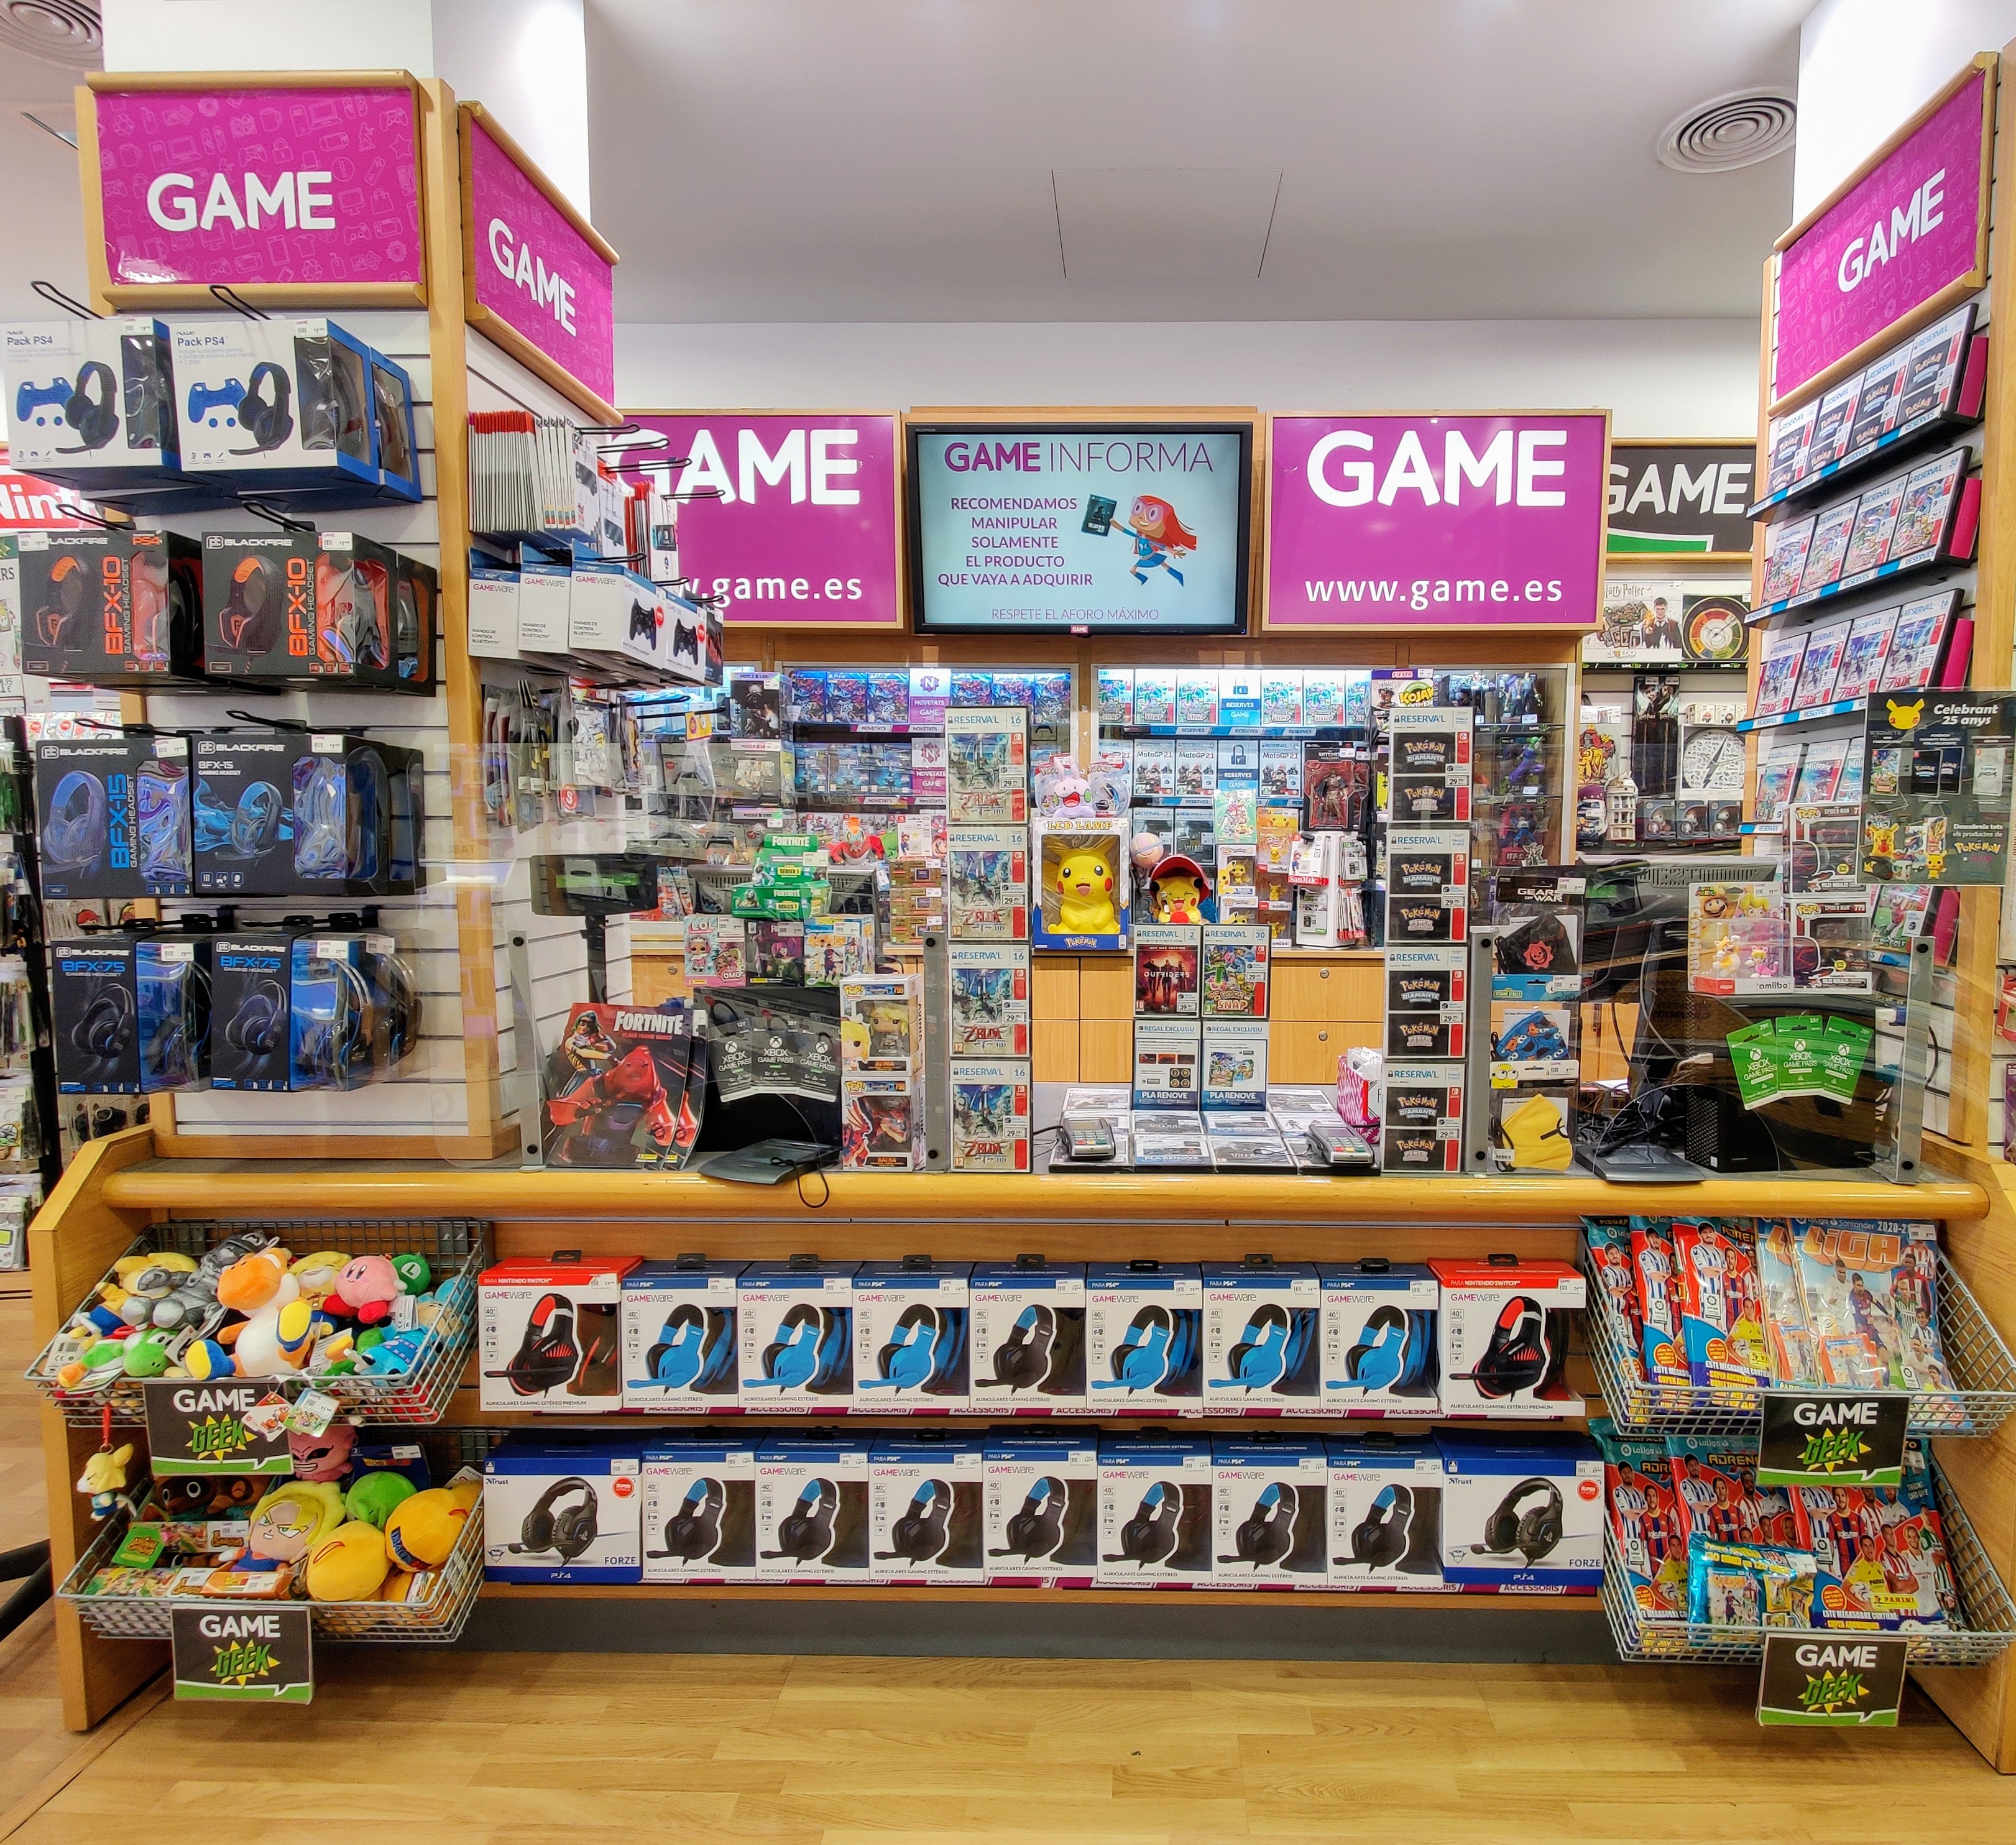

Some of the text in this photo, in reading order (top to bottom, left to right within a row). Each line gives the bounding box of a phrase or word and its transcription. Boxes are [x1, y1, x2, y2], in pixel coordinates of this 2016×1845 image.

[147, 172, 335, 232] GAME
[1838, 167, 1945, 293] GAME
[489, 218, 576, 336] GAME
[7, 336, 31, 346] Pack
[177, 337, 201, 347] Pack
[944, 442, 1213, 472] GAME INFORMA
[610, 429, 860, 505] GAME
[1306, 430, 1567, 508] GAME
[1608, 463, 1752, 515] GAME
[951, 498, 1077, 510] RECOMENDAMOS
[971, 517, 1057, 529] MANIPULAR
[48, 538, 109, 546] LACKFIRE
[224, 538, 293, 547] BLACKFIRE
[971, 536, 1059, 548] SOLAMENTE
[966, 556, 1065, 568] EL PRODUCTO
[938, 573, 1093, 587] QUE VAYA A ADQUIRIR
[1304, 577, 1562, 611] www.game.es
[102, 556, 123, 655] BFX-10
[287, 557, 308, 656] BFX-10
[992, 606, 1159, 620] RESPETE EL AFORO MÁXIMO
[1934, 704, 1999, 715] Celebrant
[1961, 716, 1991, 726] anys
[60, 747, 129, 755] BLACKFIRE
[216, 743, 285, 752] BLACKFIRE
[109, 773, 127, 868] BFX-15
[1047, 821, 1113, 829] LED LAMP
[772, 835, 811, 847] FORTNITE
[1011, 834, 1022, 842] 16
[231, 944, 287, 953] BLACKFIRE
[62, 961, 125, 973] BFX-75
[220, 956, 281, 969] BFX-75
[1759, 982, 1788, 990] amiibo
[1217, 1001, 1248, 1011] SNAP
[614, 1011, 683, 1035] FORTNITE
[722, 1051, 747, 1064] XBOX
[807, 1052, 832, 1064] XBOX
[1788, 1052, 1812, 1061] XBOX
[1828, 1054, 1851, 1067] XBOX
[1746, 1059, 1770, 1072] XBOX
[484, 1291, 532, 1300] GAMEware
[627, 1294, 673, 1303] GAMEware
[743, 1294, 789, 1302] GAMEware
[858, 1294, 905, 1302] GAMEware
[975, 1294, 1022, 1302] GAMEware
[1092, 1294, 1139, 1304] GAMEware
[1209, 1293, 1256, 1302] GAMEware
[1327, 1294, 1374, 1304] GAMEware
[1450, 1293, 1499, 1302] GAMEware
[173, 1389, 255, 1413] GAME
[1793, 1403, 1877, 1425] GAME
[1805, 1432, 1863, 1465] GEEK
[647, 1467, 693, 1476] GAMEware
[760, 1467, 806, 1476] GAMEware
[604, 1556, 637, 1565] FORZE
[1568, 1559, 1601, 1567] FORZE
[200, 1616, 280, 1638] GAME
[216, 1644, 271, 1677] GEEK
[1795, 1645, 1877, 1667] GAME
[1803, 1673, 1862, 1705] GEEK
